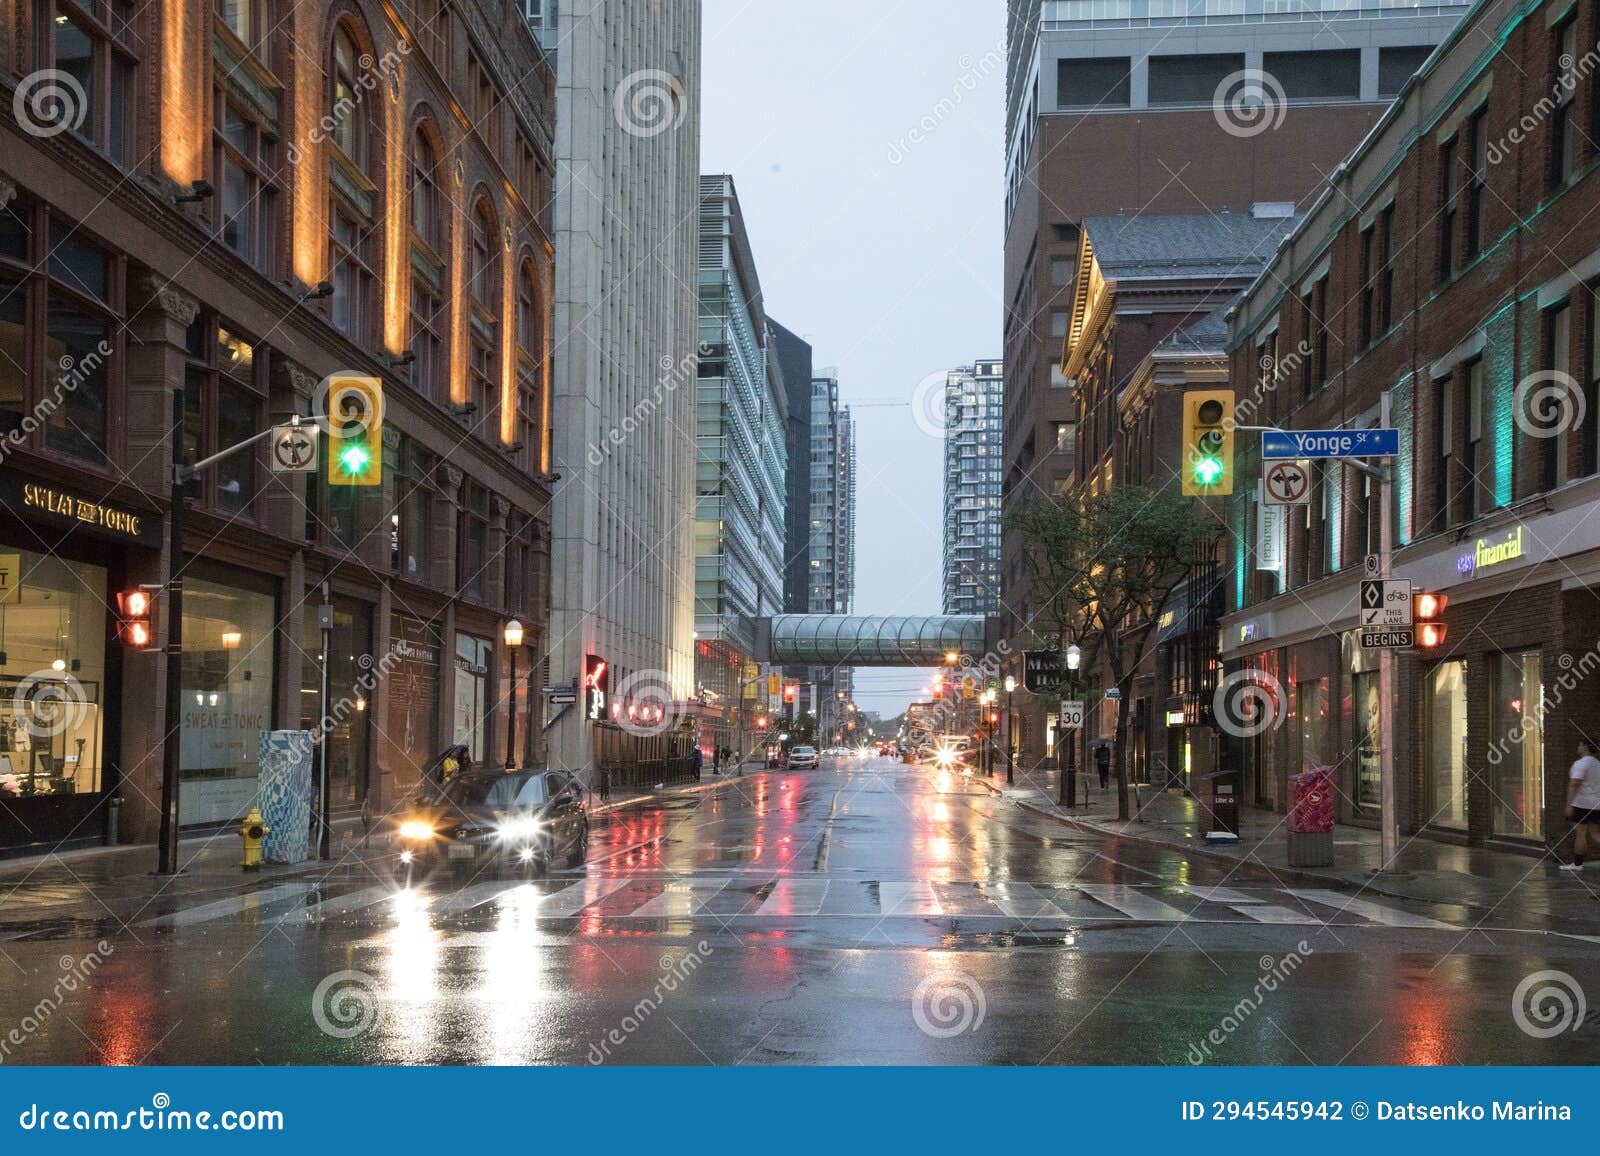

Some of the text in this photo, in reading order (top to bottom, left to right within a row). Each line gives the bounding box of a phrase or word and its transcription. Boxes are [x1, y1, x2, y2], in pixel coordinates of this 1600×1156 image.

[1295, 432, 1367, 455] Yonge St
[24, 483, 72, 517] SWEAT
[98, 505, 139, 535] TONIC
[1263, 508, 1277, 562] financial
[1366, 633, 1408, 646] BEGINS
[185, 711, 218, 729] SWEAT
[234, 713, 263, 729] TONIC
[1063, 711, 1081, 724] 30
